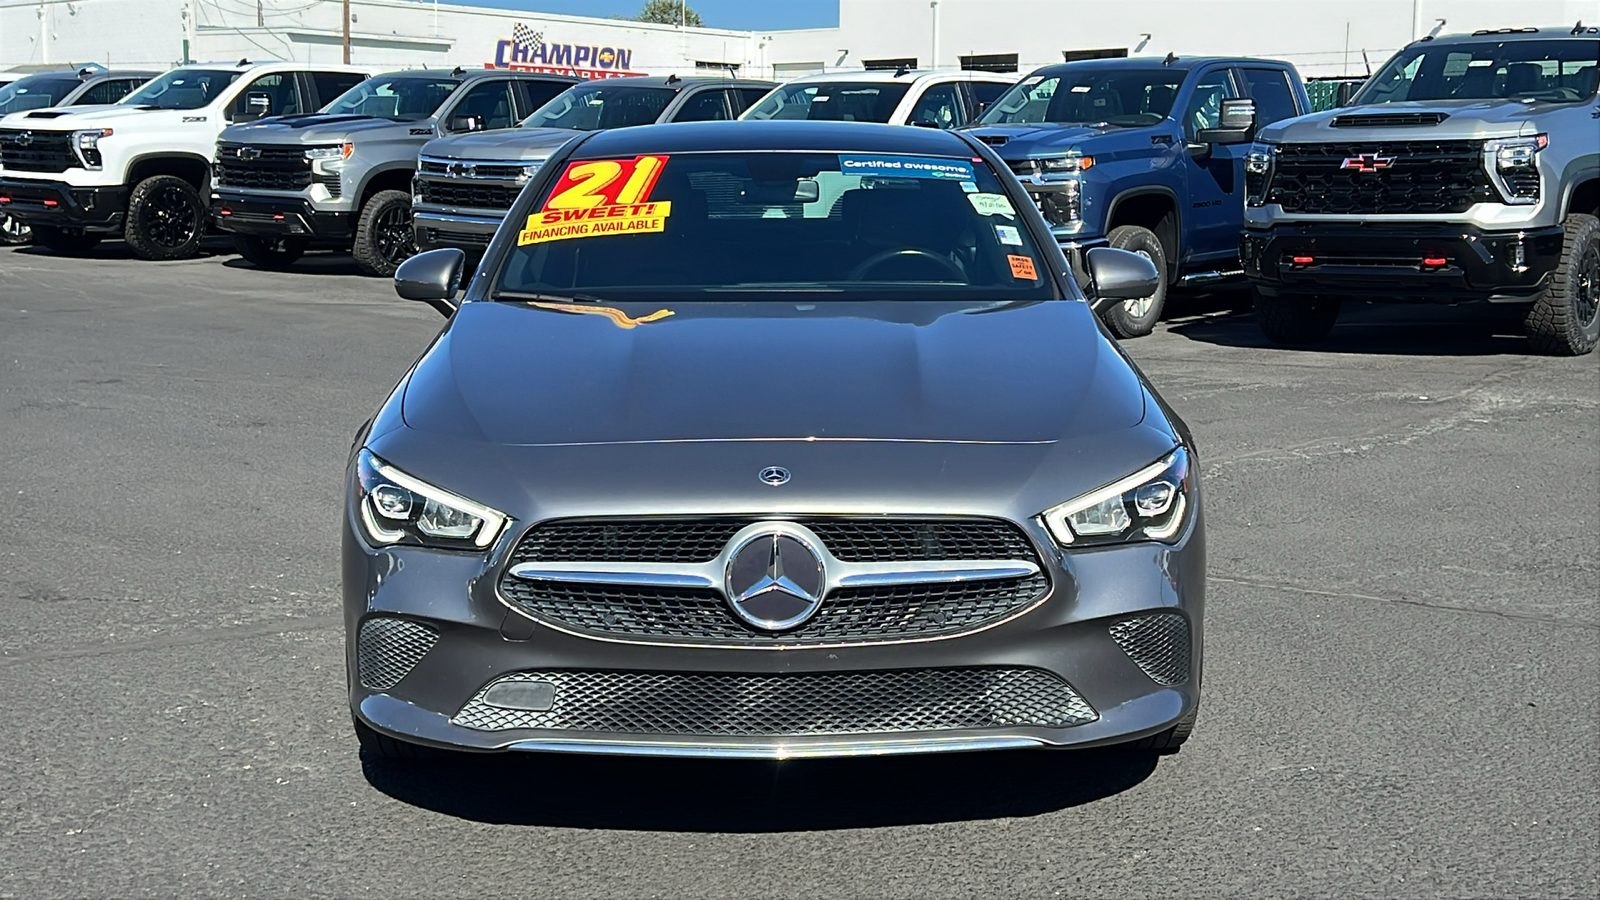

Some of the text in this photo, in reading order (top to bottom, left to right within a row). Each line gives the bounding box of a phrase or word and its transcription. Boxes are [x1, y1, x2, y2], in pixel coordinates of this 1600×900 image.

[495, 39, 632, 70] CHAMPION
[844, 160, 901, 169] Certified
[547, 156, 662, 209] 21
[541, 203, 657, 225] SWEET!
[522, 218, 660, 243] FINANCING AVAILABLE
